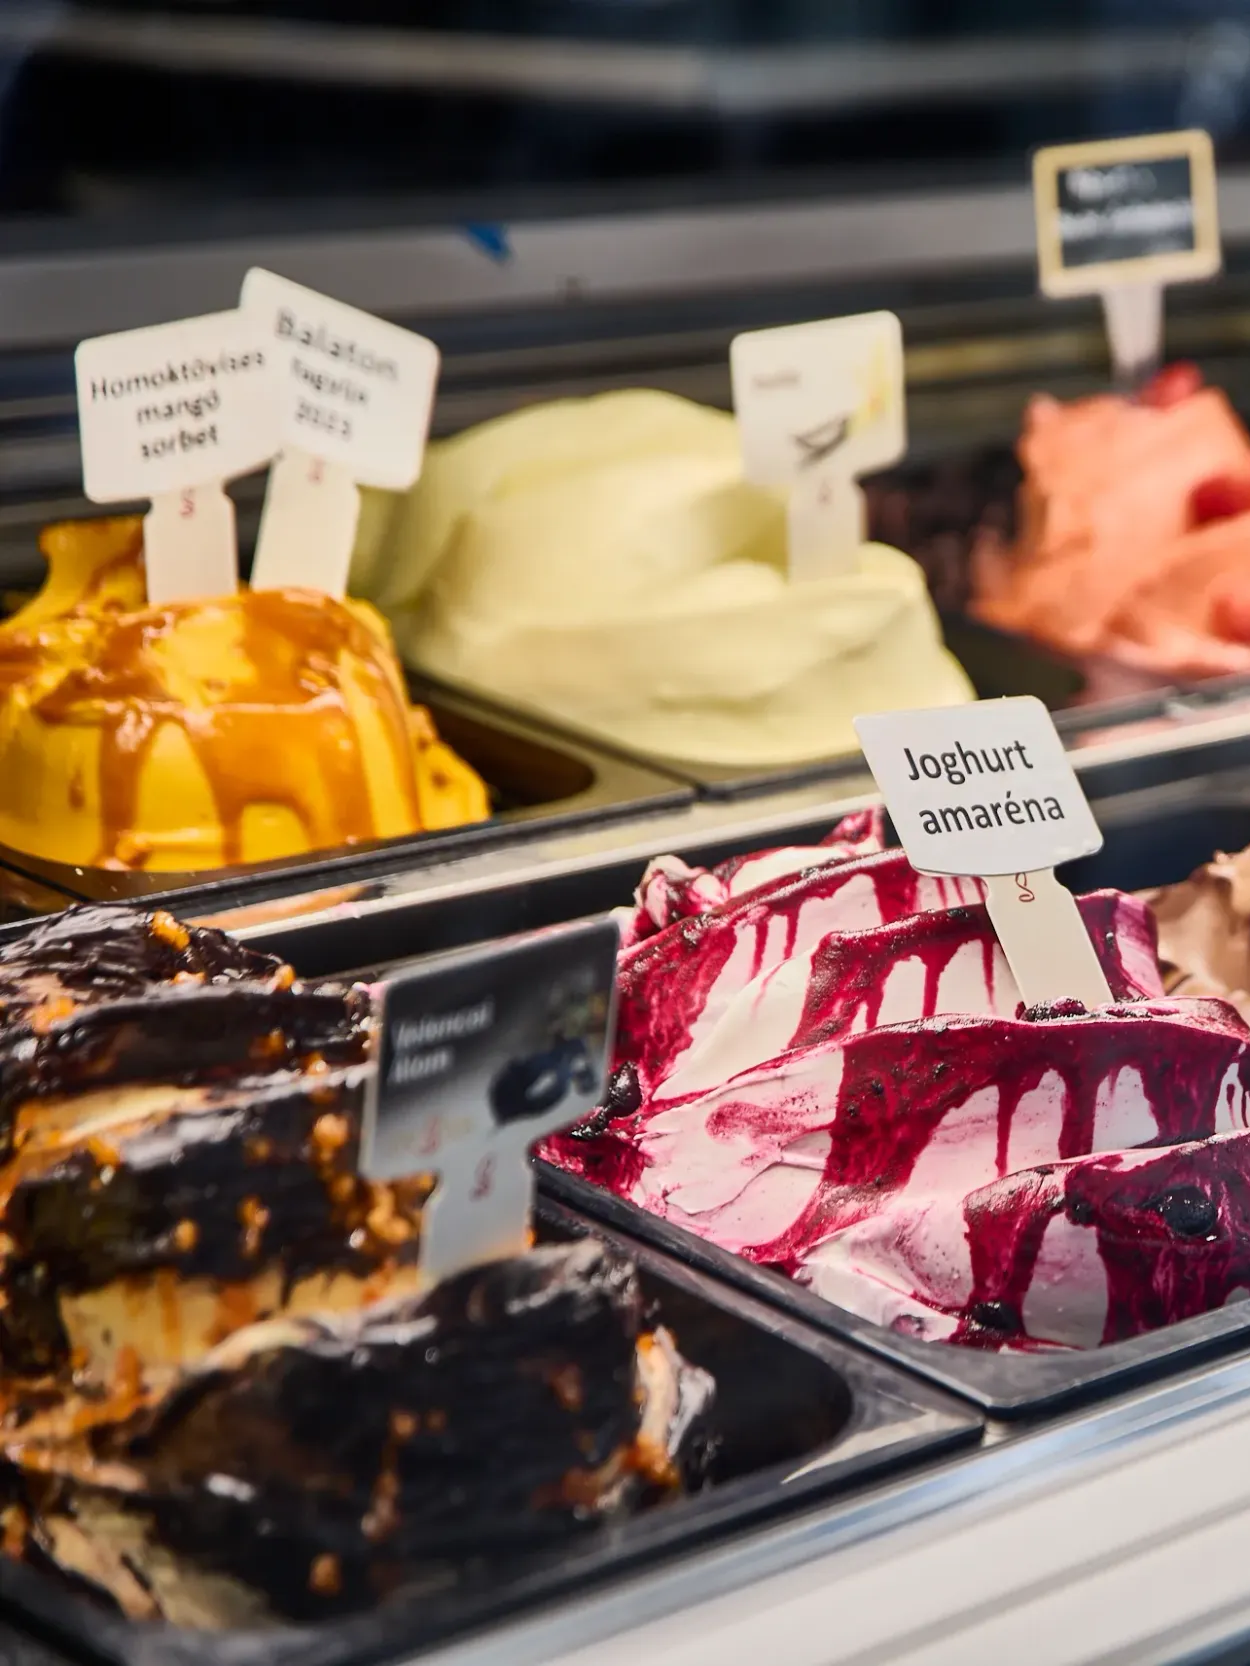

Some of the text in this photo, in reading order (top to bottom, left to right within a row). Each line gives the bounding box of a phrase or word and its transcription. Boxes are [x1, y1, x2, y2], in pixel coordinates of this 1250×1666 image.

[276, 309, 398, 381] Balaton
[140, 424, 219, 460] sorbet
[903, 740, 1034, 785] Joghurt
[919, 791, 1066, 835] amaréna
